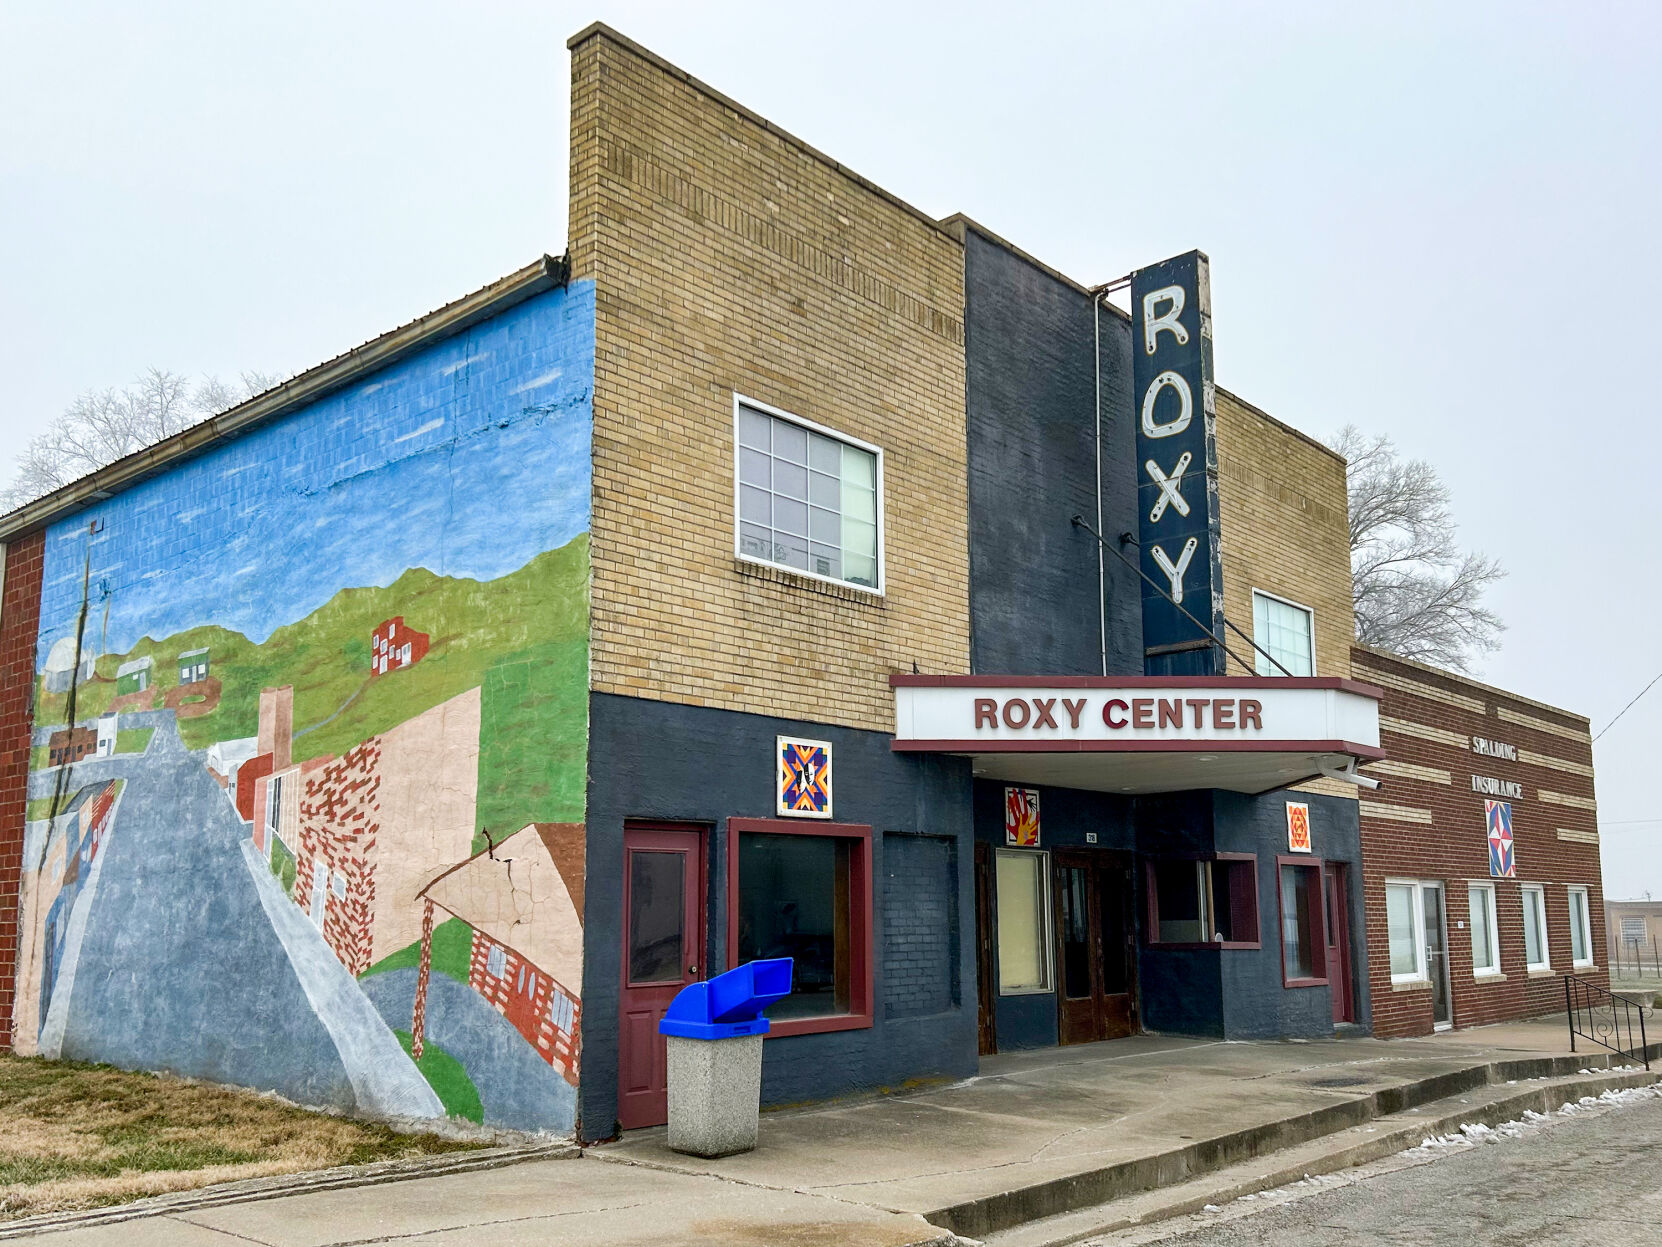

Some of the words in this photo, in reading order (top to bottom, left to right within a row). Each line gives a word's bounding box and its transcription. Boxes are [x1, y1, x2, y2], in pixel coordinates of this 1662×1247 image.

[1141, 284, 1198, 604] ROXY
[974, 698, 1087, 729] ROXY
[1102, 698, 1263, 730] CENTER
[1472, 736, 1516, 761] SPALDING
[1471, 774, 1523, 799] INSURANCE
